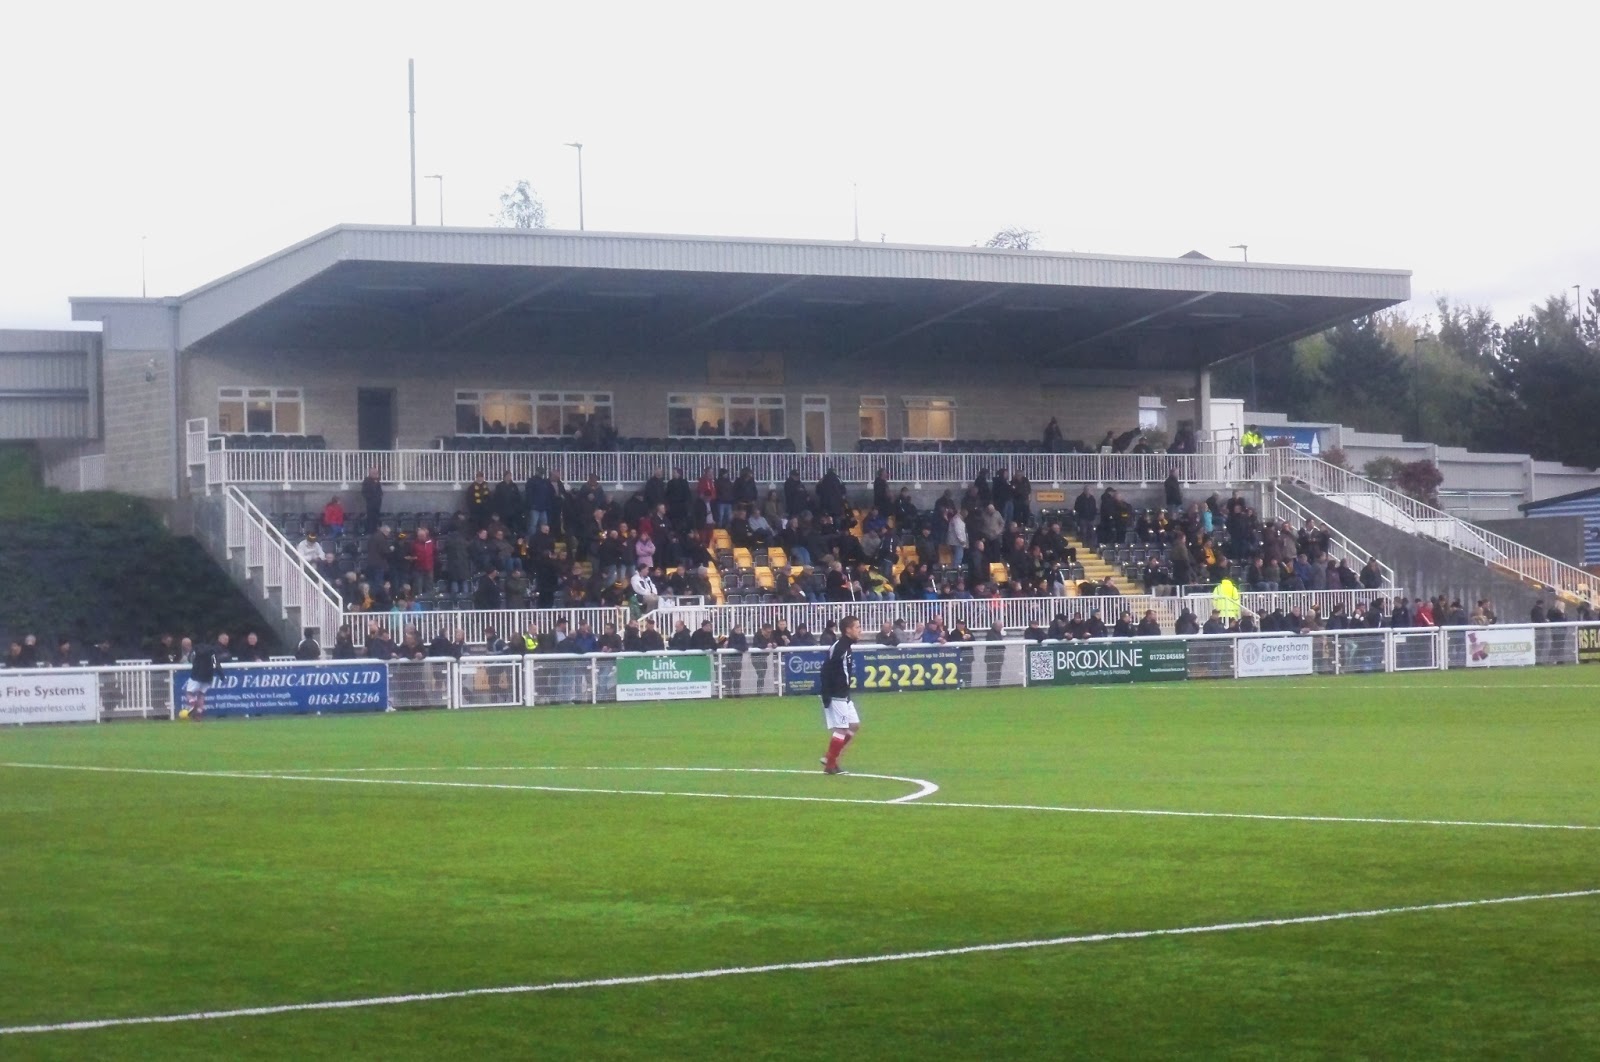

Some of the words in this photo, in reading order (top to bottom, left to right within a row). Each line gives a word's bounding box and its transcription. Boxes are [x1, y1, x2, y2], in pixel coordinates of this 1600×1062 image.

[1262, 642, 1309, 652] Faversham
[1057, 649, 1143, 670] BROOKLINE
[1262, 654, 1280, 662] Linen
[1282, 653, 1309, 661] Services
[653, 659, 676, 671] Link
[242, 672, 350, 689] FABRICATIONS
[353, 671, 381, 685] LTD
[636, 669, 692, 681] Pharmacy
[6, 686, 30, 698] Fire
[34, 685, 85, 700] Systems
[308, 693, 340, 706] 01634
[343, 692, 381, 704] 255266
